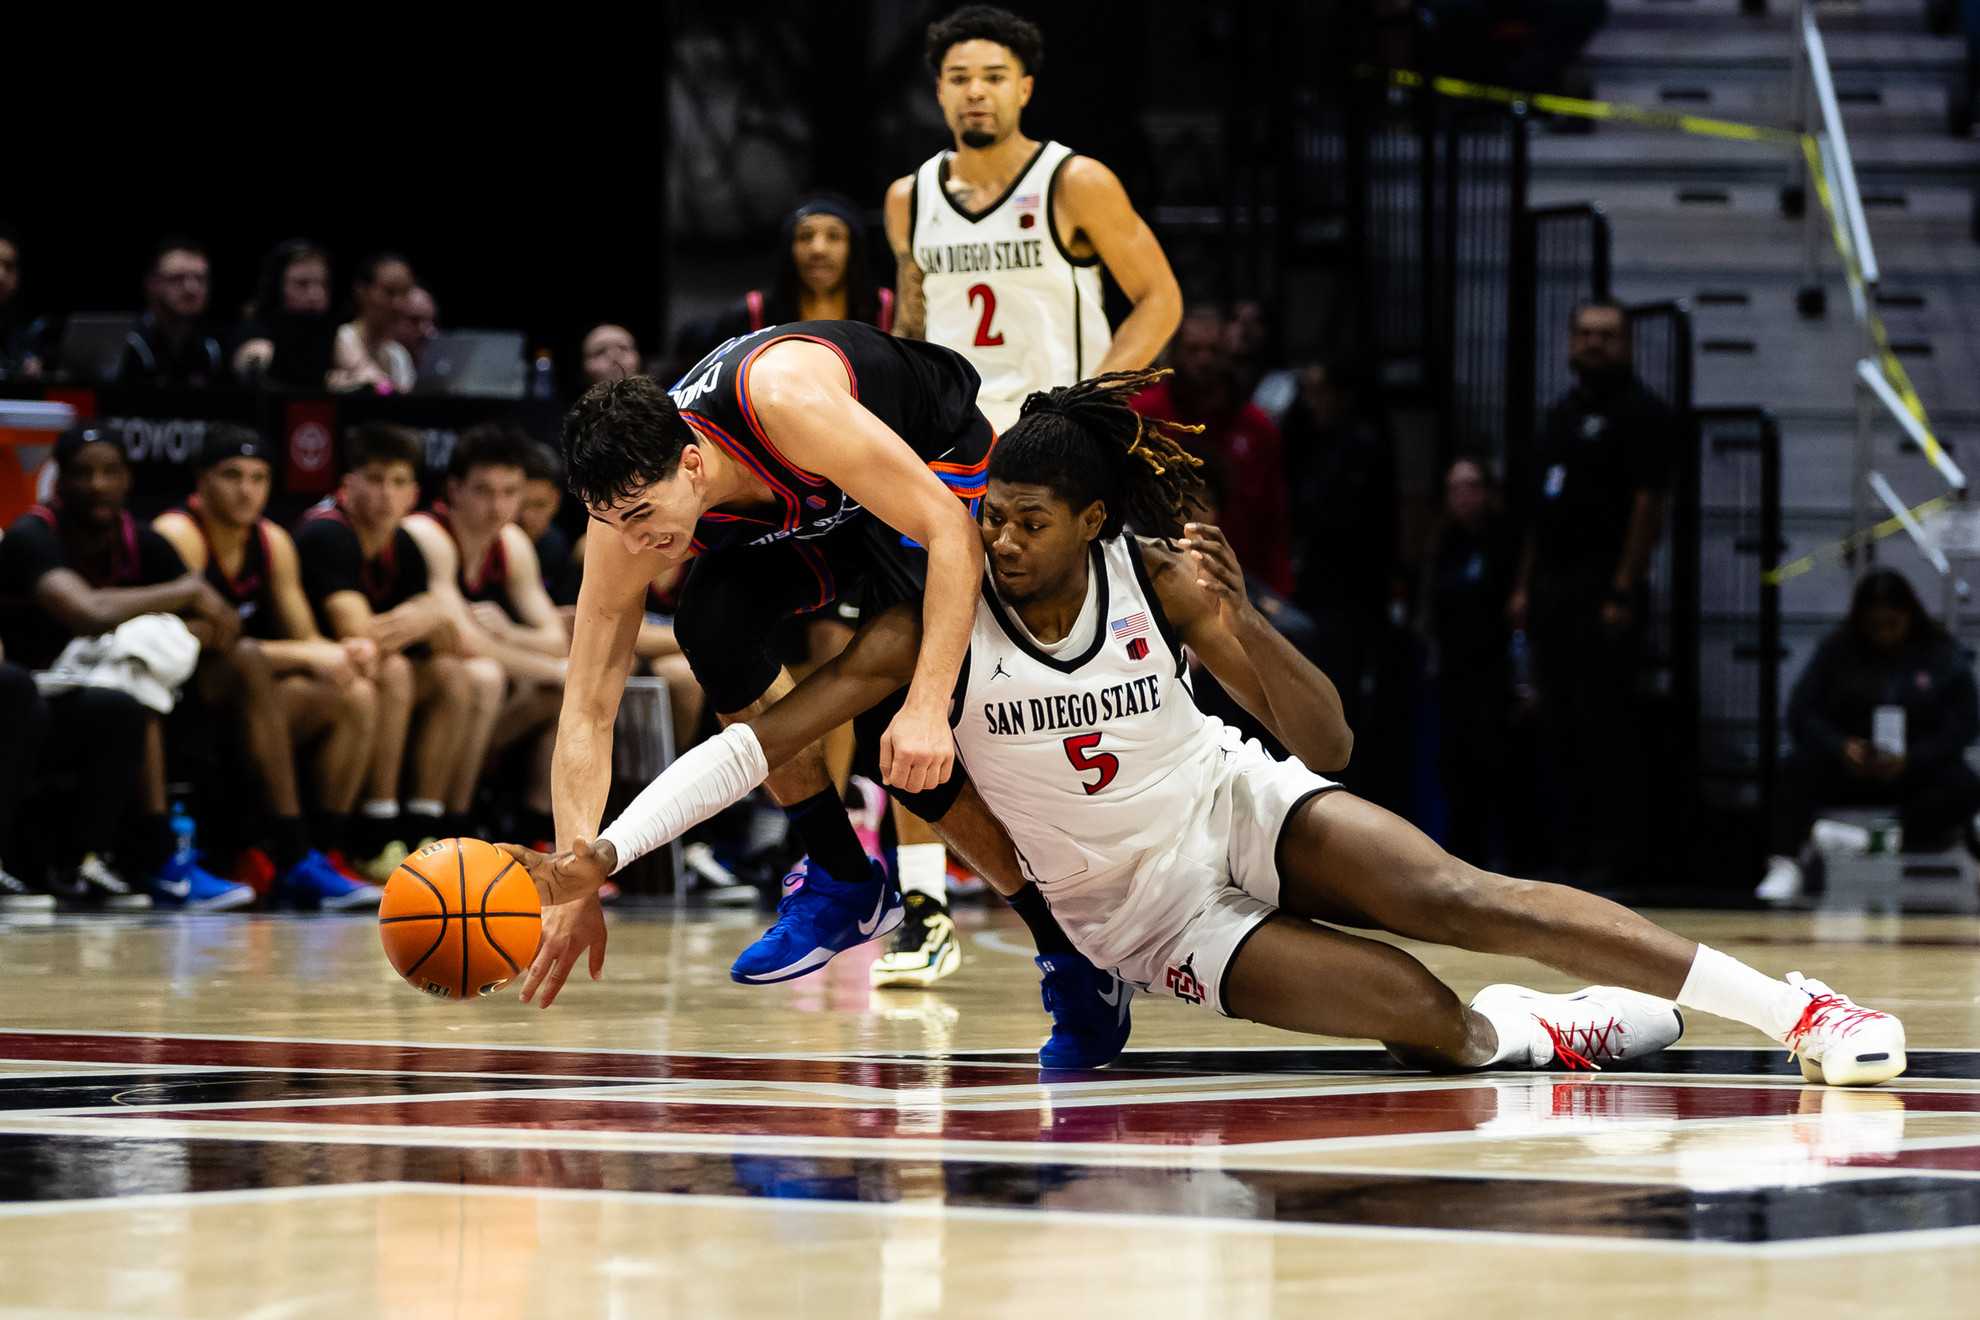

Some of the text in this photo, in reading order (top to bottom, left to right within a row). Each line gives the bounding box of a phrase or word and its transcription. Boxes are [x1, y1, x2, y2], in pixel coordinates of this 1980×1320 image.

[920, 239, 1043, 274] SAN DIEGO STATE
[967, 282, 1005, 347] 2
[984, 674, 1161, 735] SAN DIEGO STATE
[1062, 731, 1120, 796] 5
